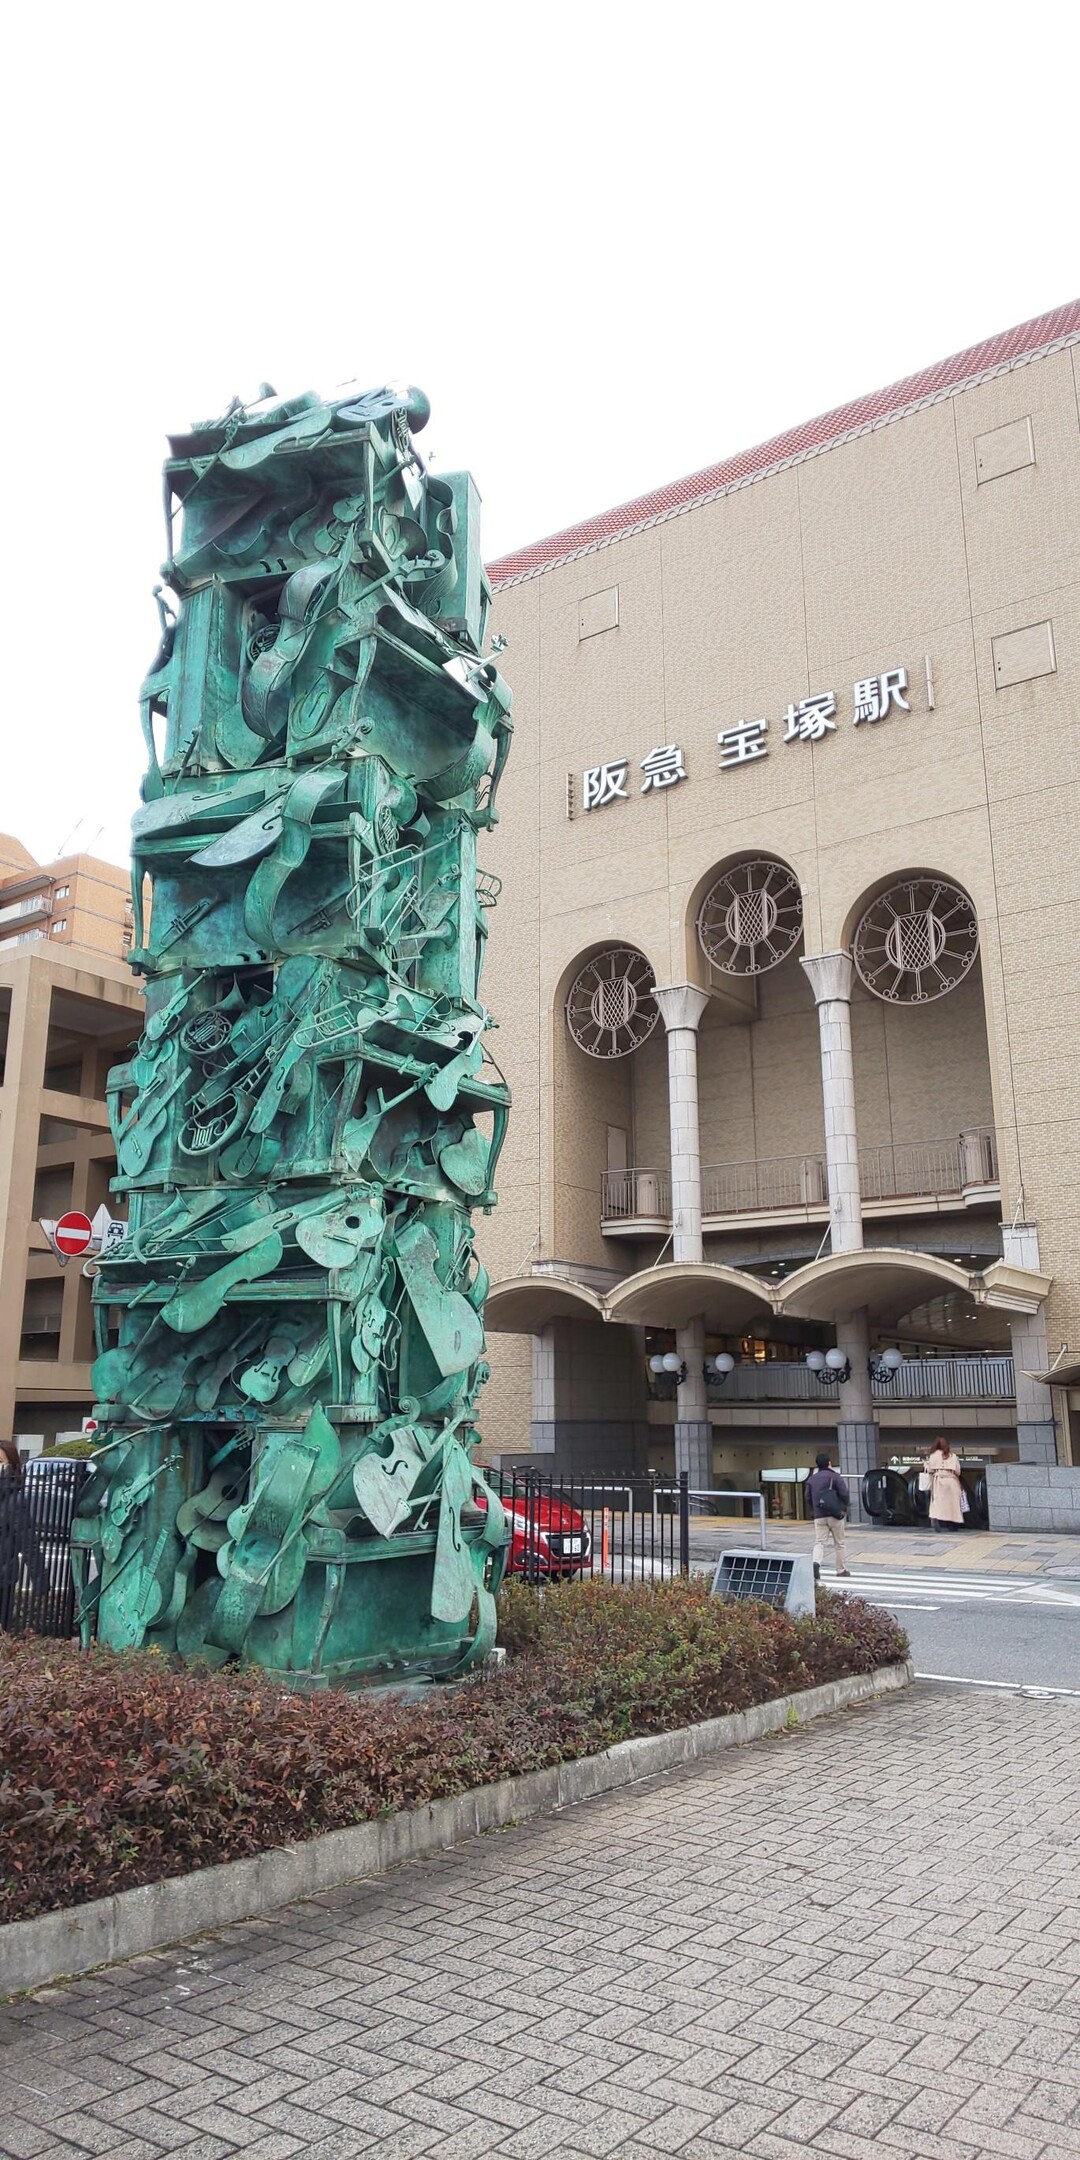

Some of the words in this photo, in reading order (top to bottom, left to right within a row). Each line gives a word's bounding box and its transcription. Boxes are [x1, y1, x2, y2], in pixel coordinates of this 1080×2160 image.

[583, 744, 689, 811] 阪急
[717, 667, 911, 770] 宝塚駅
